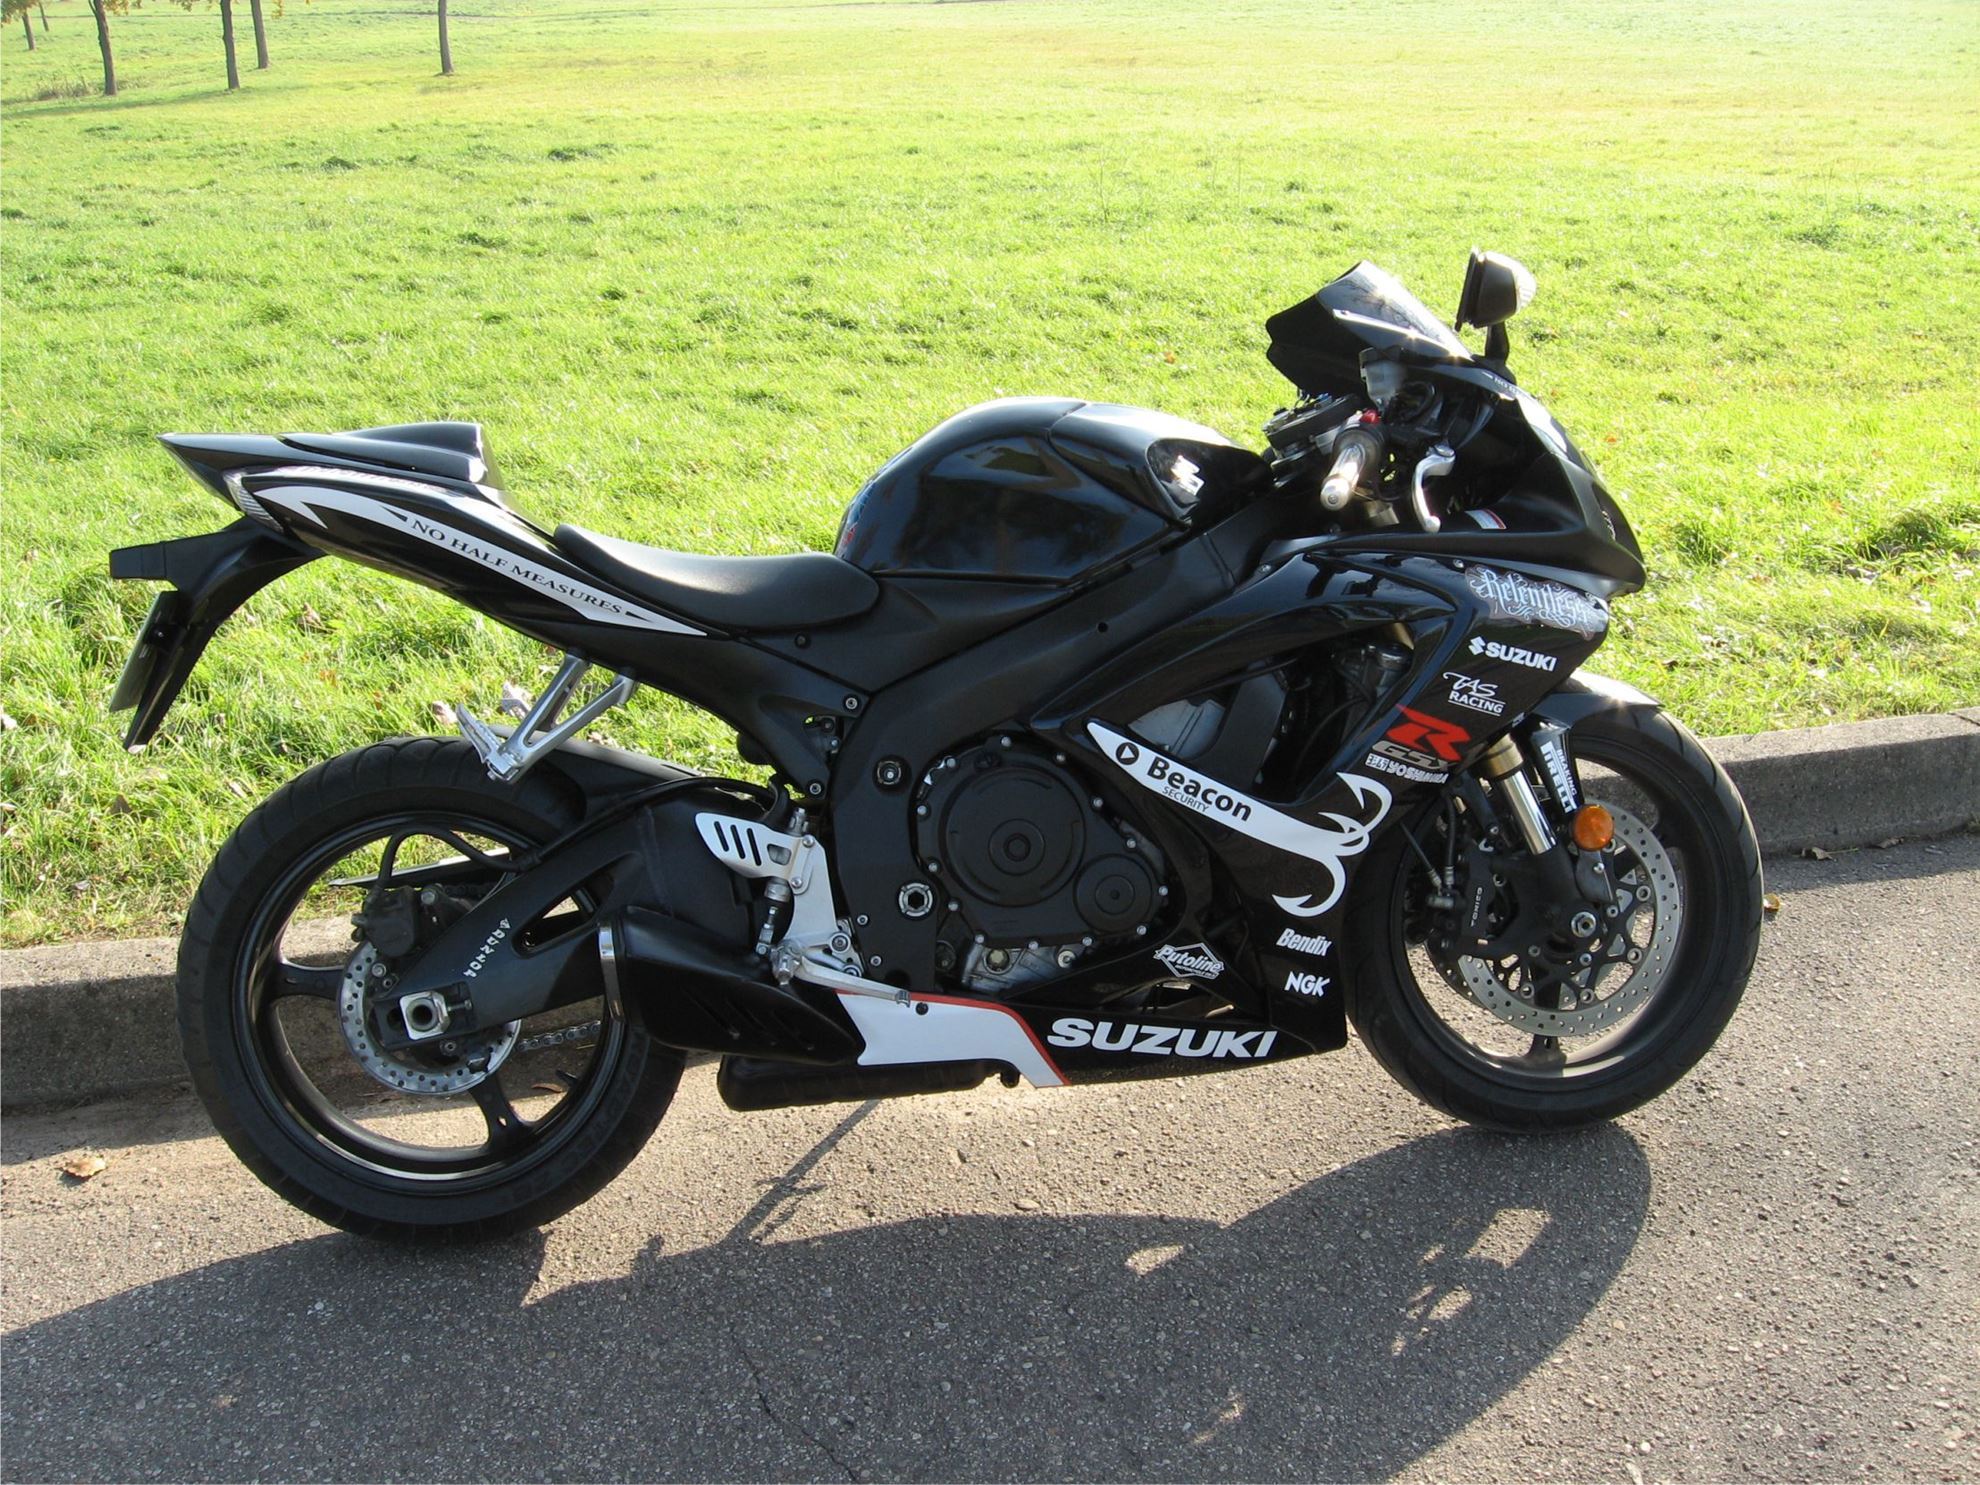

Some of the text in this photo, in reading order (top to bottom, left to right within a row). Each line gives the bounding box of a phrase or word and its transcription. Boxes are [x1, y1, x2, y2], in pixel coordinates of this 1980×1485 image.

[411, 520, 622, 613] NO HALF MEASURES
[1485, 641, 1557, 672] SUZUKI
[1443, 671, 1499, 697] TAS
[1448, 690, 1505, 714] RACING
[1556, 748, 1578, 796] BRAKING
[1146, 756, 1253, 822] Beacon
[1162, 785, 1210, 814] SECURITY
[463, 928, 506, 978] DUNLOP
[1276, 927, 1332, 957] Bendix
[1155, 946, 1222, 974] Putoline
[1284, 971, 1331, 997] NGK
[1047, 1017, 1278, 1058] SUZUKI
